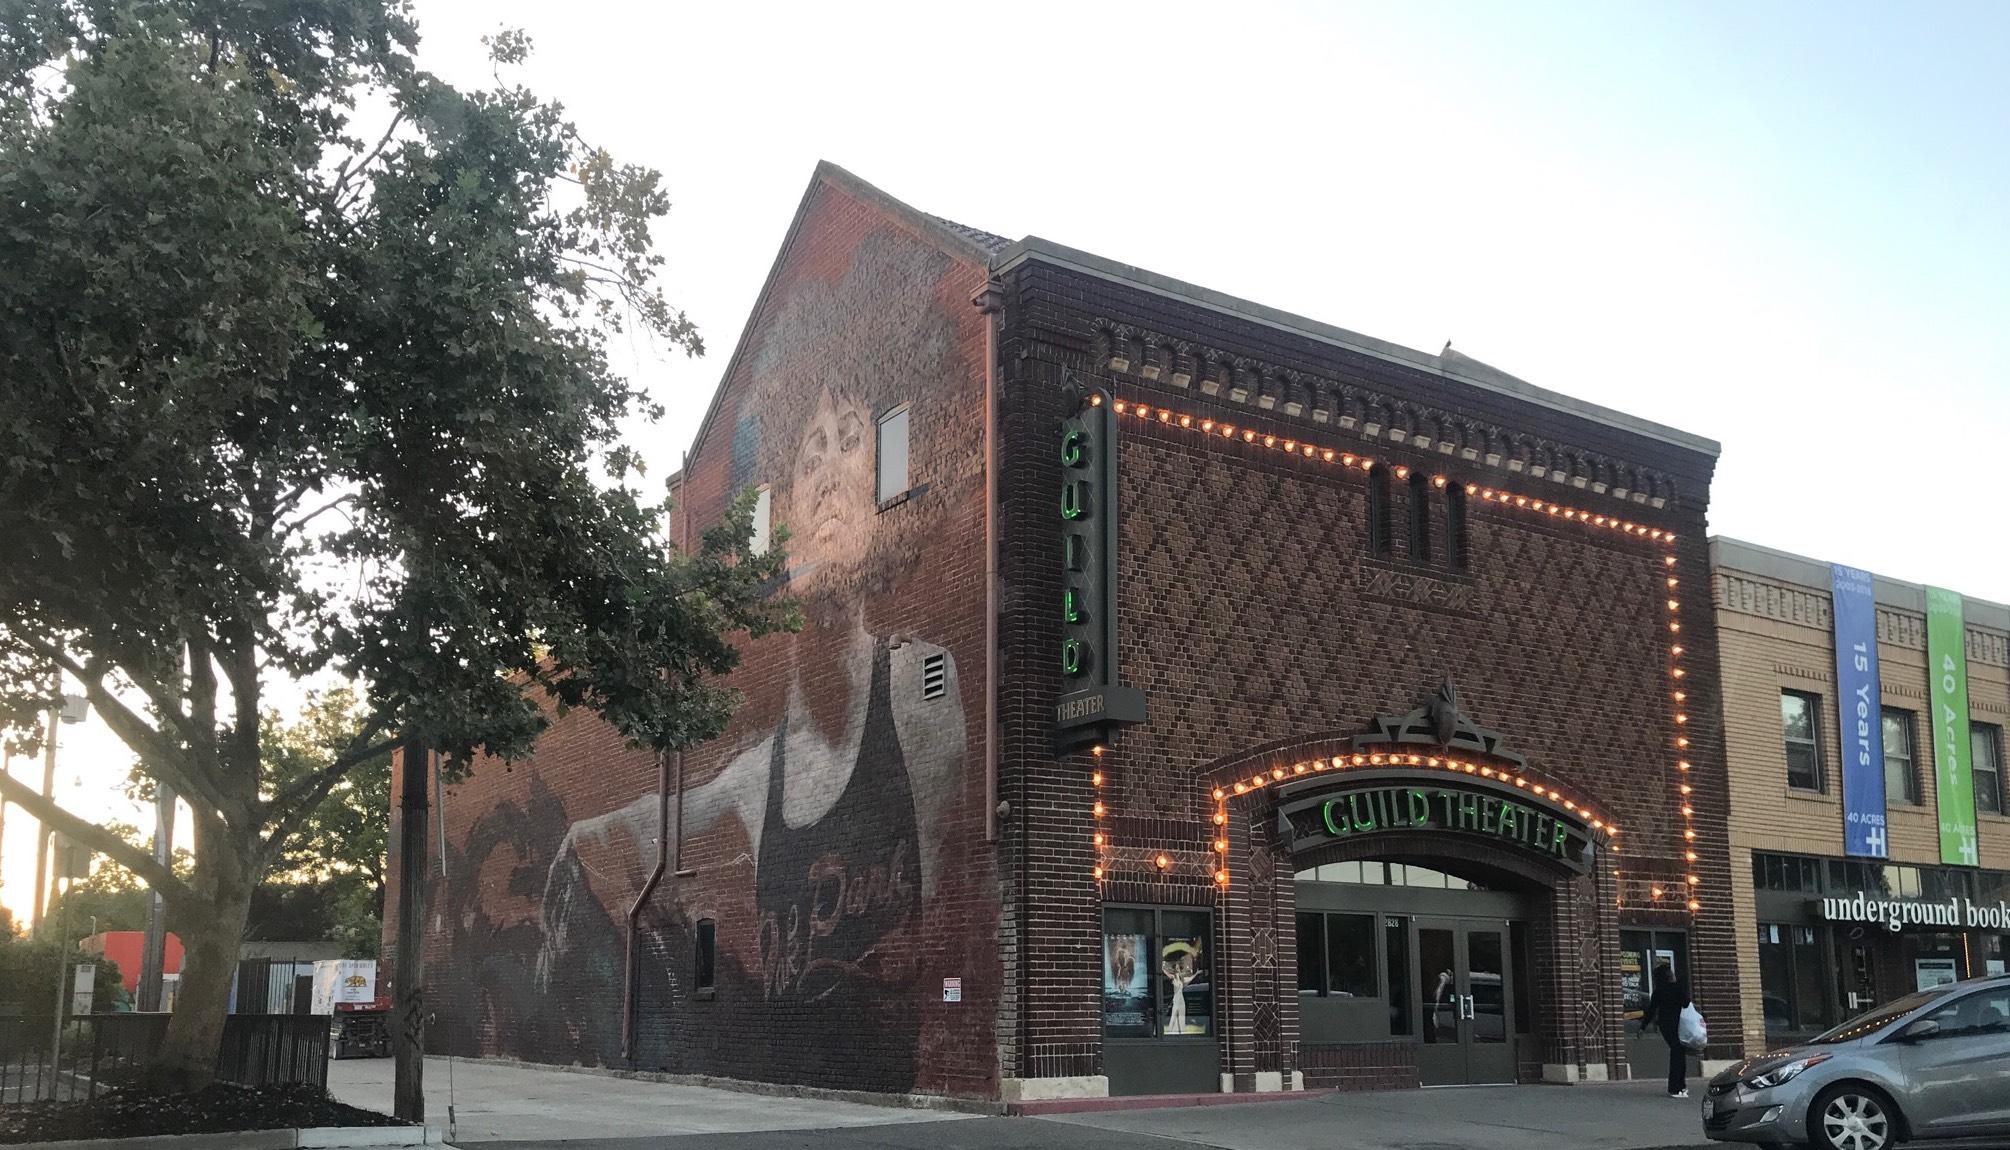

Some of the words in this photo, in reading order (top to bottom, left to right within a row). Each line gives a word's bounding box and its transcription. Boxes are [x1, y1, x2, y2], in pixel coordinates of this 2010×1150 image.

[1061, 431, 1081, 675] GUILD
[1853, 641, 1869, 672] 15
[1942, 653, 1957, 694] 40
[1056, 694, 1105, 722] THEATER
[1856, 683, 1871, 767] Years
[1943, 703, 1958, 786] Acres
[1321, 789, 1430, 838] GUILD
[1437, 790, 1568, 858] THEATER
[1847, 811, 1859, 824] 40
[1860, 813, 1885, 826] ACRES
[1823, 890, 1961, 932] underground
[1965, 897, 2010, 929] book
